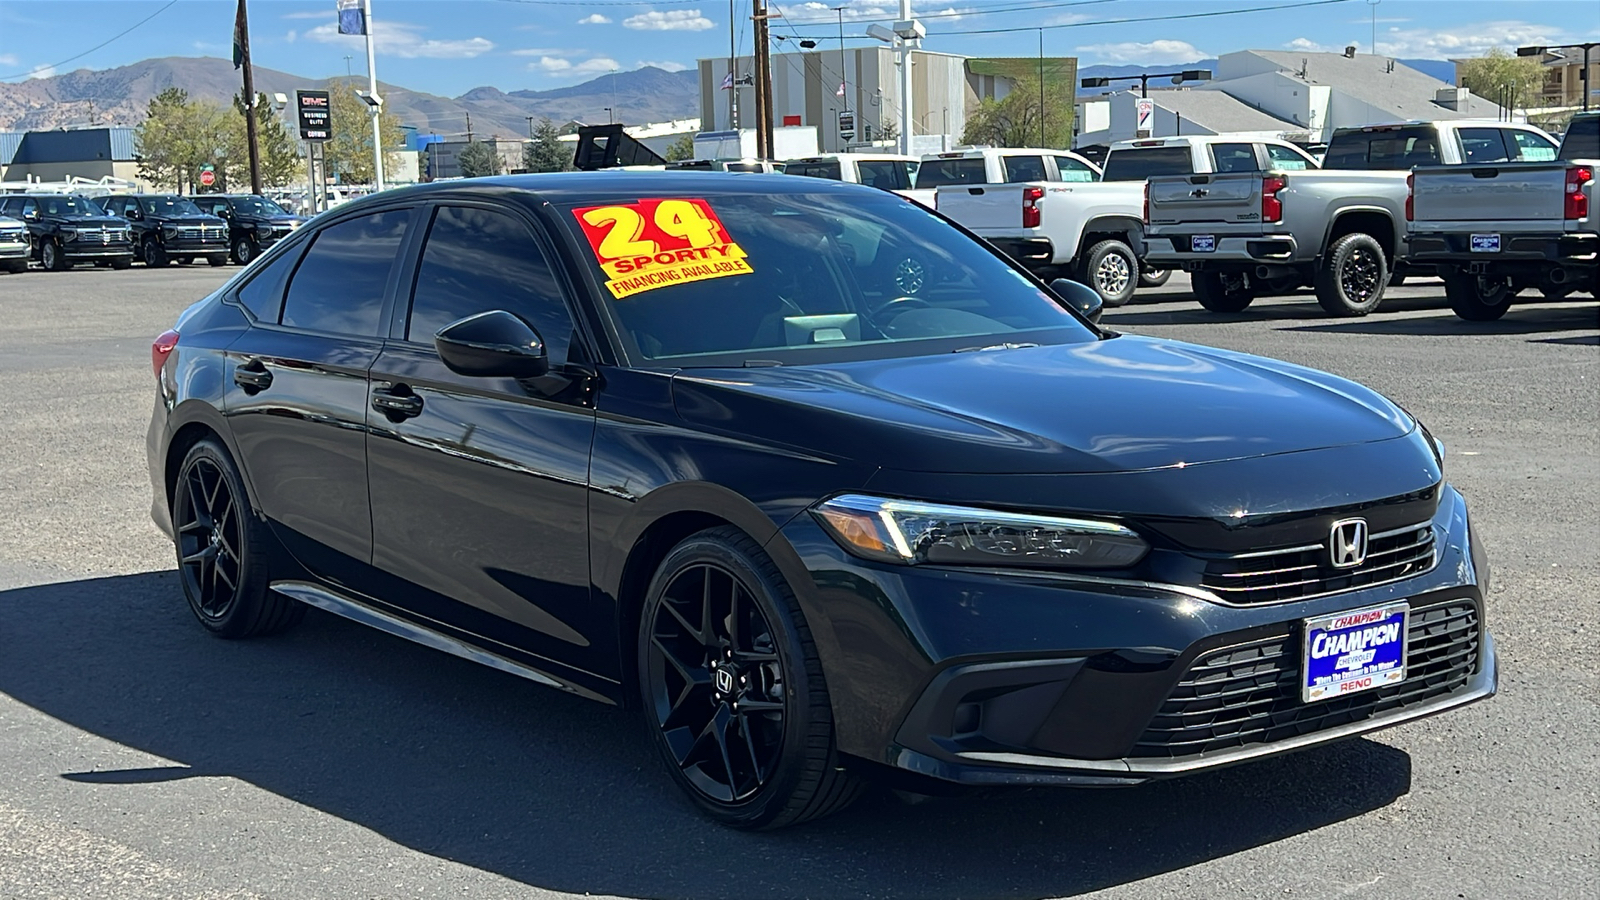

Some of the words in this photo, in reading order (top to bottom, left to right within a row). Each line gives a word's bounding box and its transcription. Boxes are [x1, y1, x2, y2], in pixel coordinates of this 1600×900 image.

[302, 97, 327, 106] GMC
[582, 200, 721, 258] 24
[614, 245, 729, 273] SPORTY
[612, 269, 682, 294] FINANCING
[683, 261, 747, 279] AVAILABLE
[1335, 611, 1382, 628] CHAMPION
[1311, 622, 1400, 659] CHAMPION
[1339, 653, 1372, 666] CHEVROLET
[1340, 677, 1372, 692] RENO
